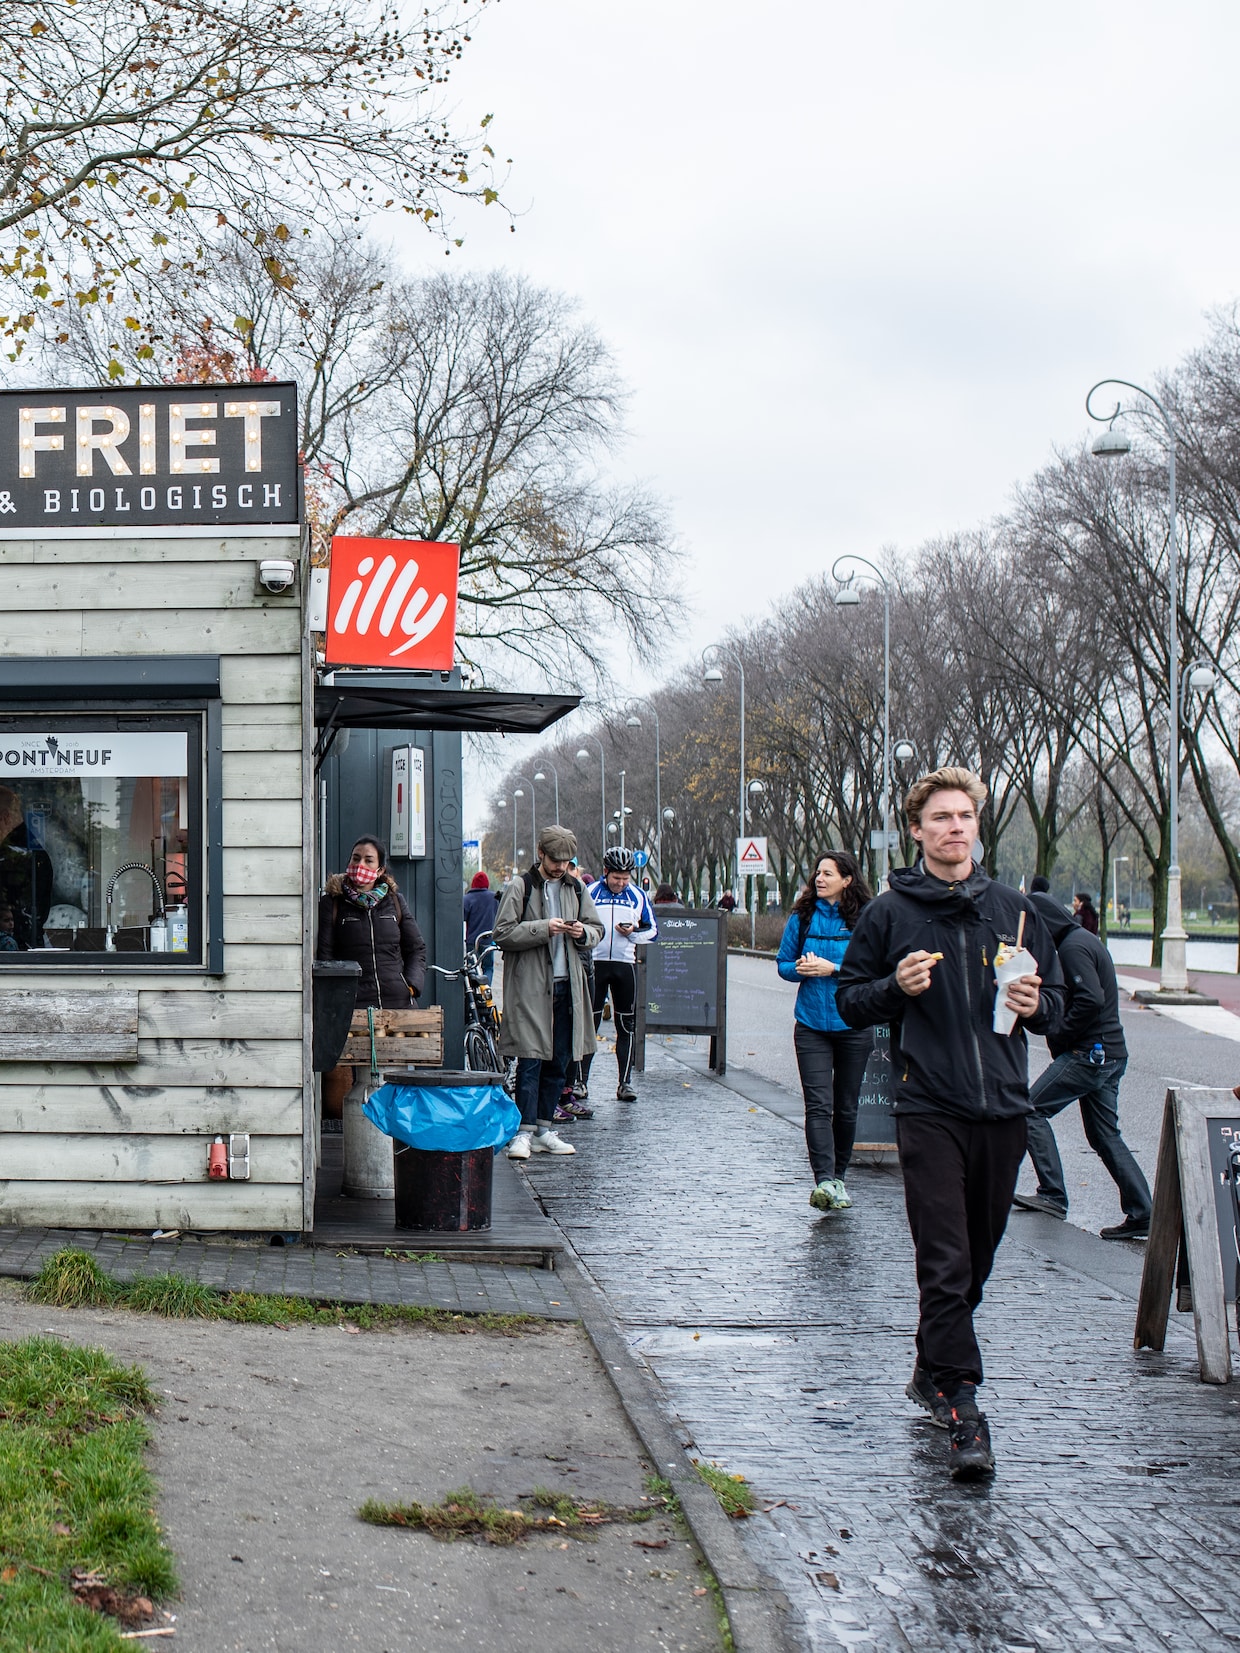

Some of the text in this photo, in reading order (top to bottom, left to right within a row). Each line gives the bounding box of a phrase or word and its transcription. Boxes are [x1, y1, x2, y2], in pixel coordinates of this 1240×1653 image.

[18, 400, 282, 479] FRIET
[44, 483, 282, 514] BIOLOGISCH
[334, 554, 448, 656] illy
[57, 750, 112, 766] NEUF
